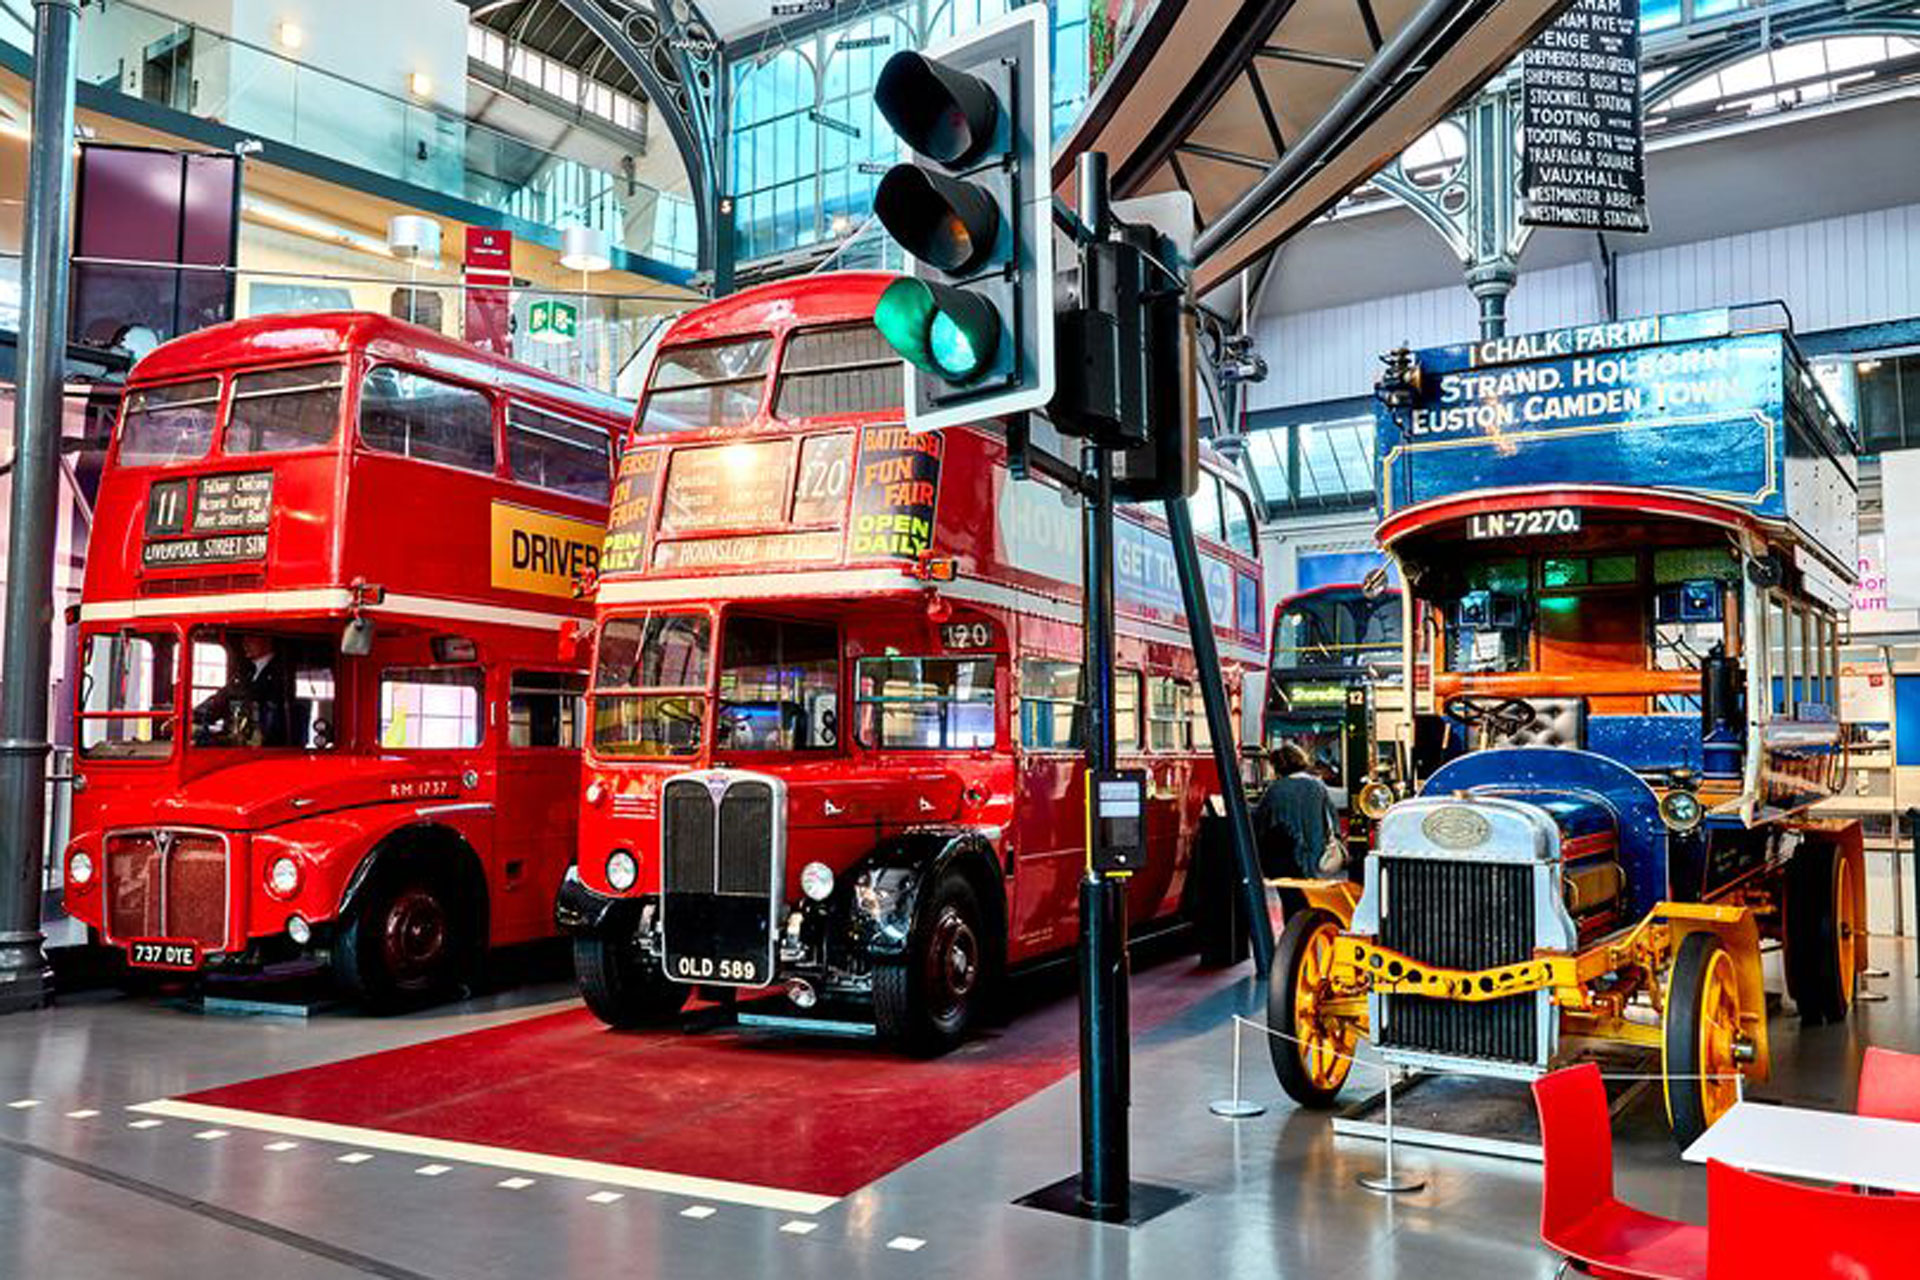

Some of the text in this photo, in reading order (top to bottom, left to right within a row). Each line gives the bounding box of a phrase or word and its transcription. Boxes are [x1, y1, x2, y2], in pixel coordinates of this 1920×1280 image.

[1573, 0, 1621, 13] HAM
[1554, 12, 1588, 29] HAM
[1591, 14, 1617, 32] RYE
[1525, 49, 1636, 74] SHEPHERDS BUSH GREEN
[1525, 69, 1586, 88] SHEPHERDS
[1589, 72, 1619, 91] BUSH
[1530, 88, 1632, 113] STOCKWELL STATION
[1530, 108, 1601, 128] TOOTING
[1526, 127, 1581, 146] TOOTING
[1586, 131, 1612, 148] STN
[1528, 147, 1636, 172] TRAFALGAR SQUARE
[1540, 166, 1629, 190] VAUXHALL
[1528, 186, 1602, 205] WESTMINSTER
[1528, 205, 1644, 227] WESTMINSTER STATION
[1480, 323, 1650, 364] CHALK FARM
[1524, 388, 1641, 422] CAMDEN
[864, 456, 914, 487] FUN
[885, 481, 934, 506] FAIR
[157, 490, 177, 526] 11
[857, 514, 929, 539] OPEN
[144, 540, 200, 561] LIVERPOOL
[203, 536, 243, 557] STREET
[603, 532, 643, 551] PEN
[854, 533, 927, 555] DAILY
[600, 551, 640, 570] AILY
[1117, 538, 1152, 582] GET
[419, 781, 447, 795] 1737
[135, 945, 193, 965] 737 DYE
[679, 957, 756, 980] OLD 589
